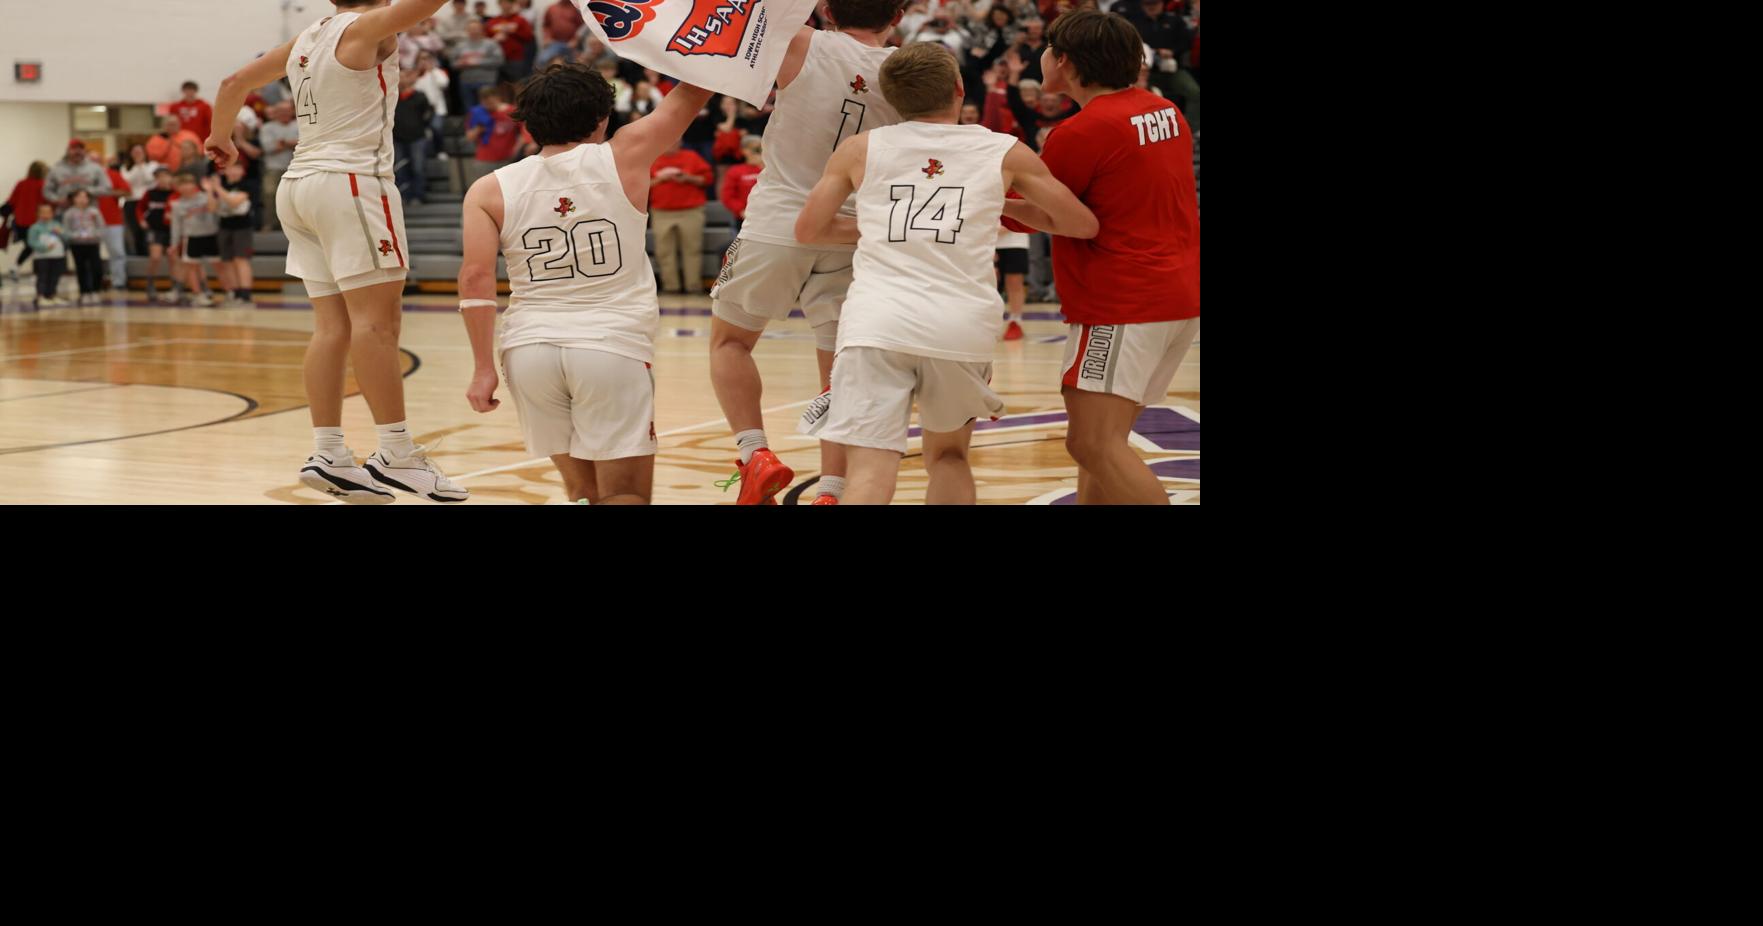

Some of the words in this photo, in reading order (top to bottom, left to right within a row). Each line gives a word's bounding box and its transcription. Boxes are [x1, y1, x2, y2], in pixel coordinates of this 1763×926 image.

[675, 0, 747, 50] IHSAA
[745, 42, 755, 60] IOWA
[752, 24, 761, 41] HIGH
[750, 38, 762, 69] ATHLETIC
[297, 76, 317, 124] 4
[1130, 107, 1179, 146] TGHT
[888, 184, 965, 244] 14
[522, 218, 622, 282] 20
